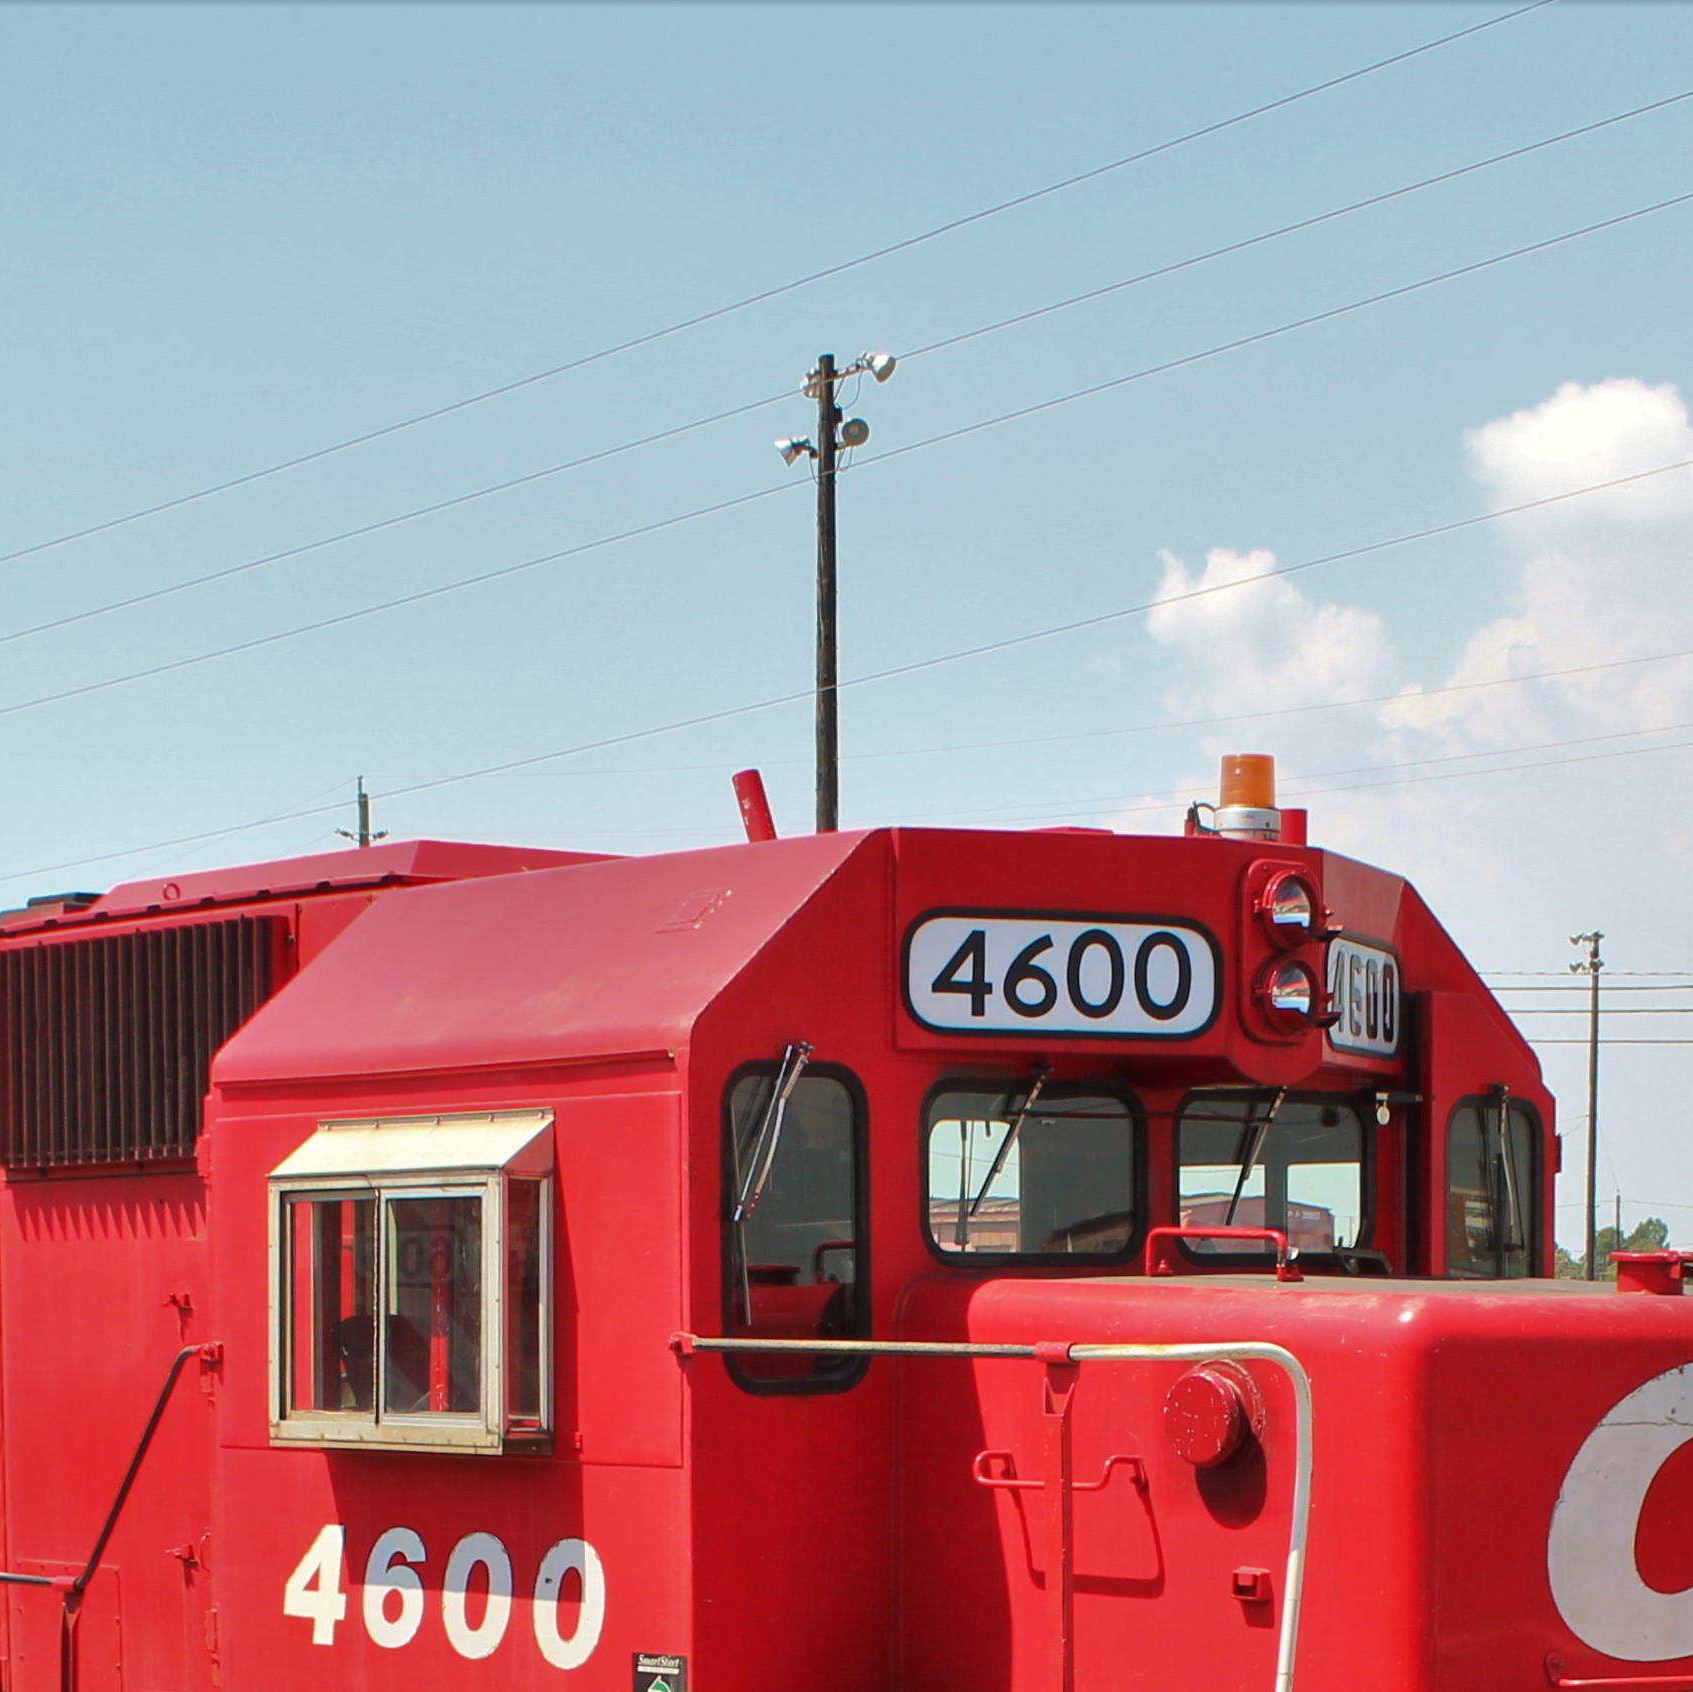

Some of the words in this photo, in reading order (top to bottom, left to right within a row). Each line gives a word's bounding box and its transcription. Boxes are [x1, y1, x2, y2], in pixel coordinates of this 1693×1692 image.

[931, 928, 1192, 1021] 4600
[1331, 945, 1395, 1043] 4600
[283, 1524, 606, 1671] 4600
